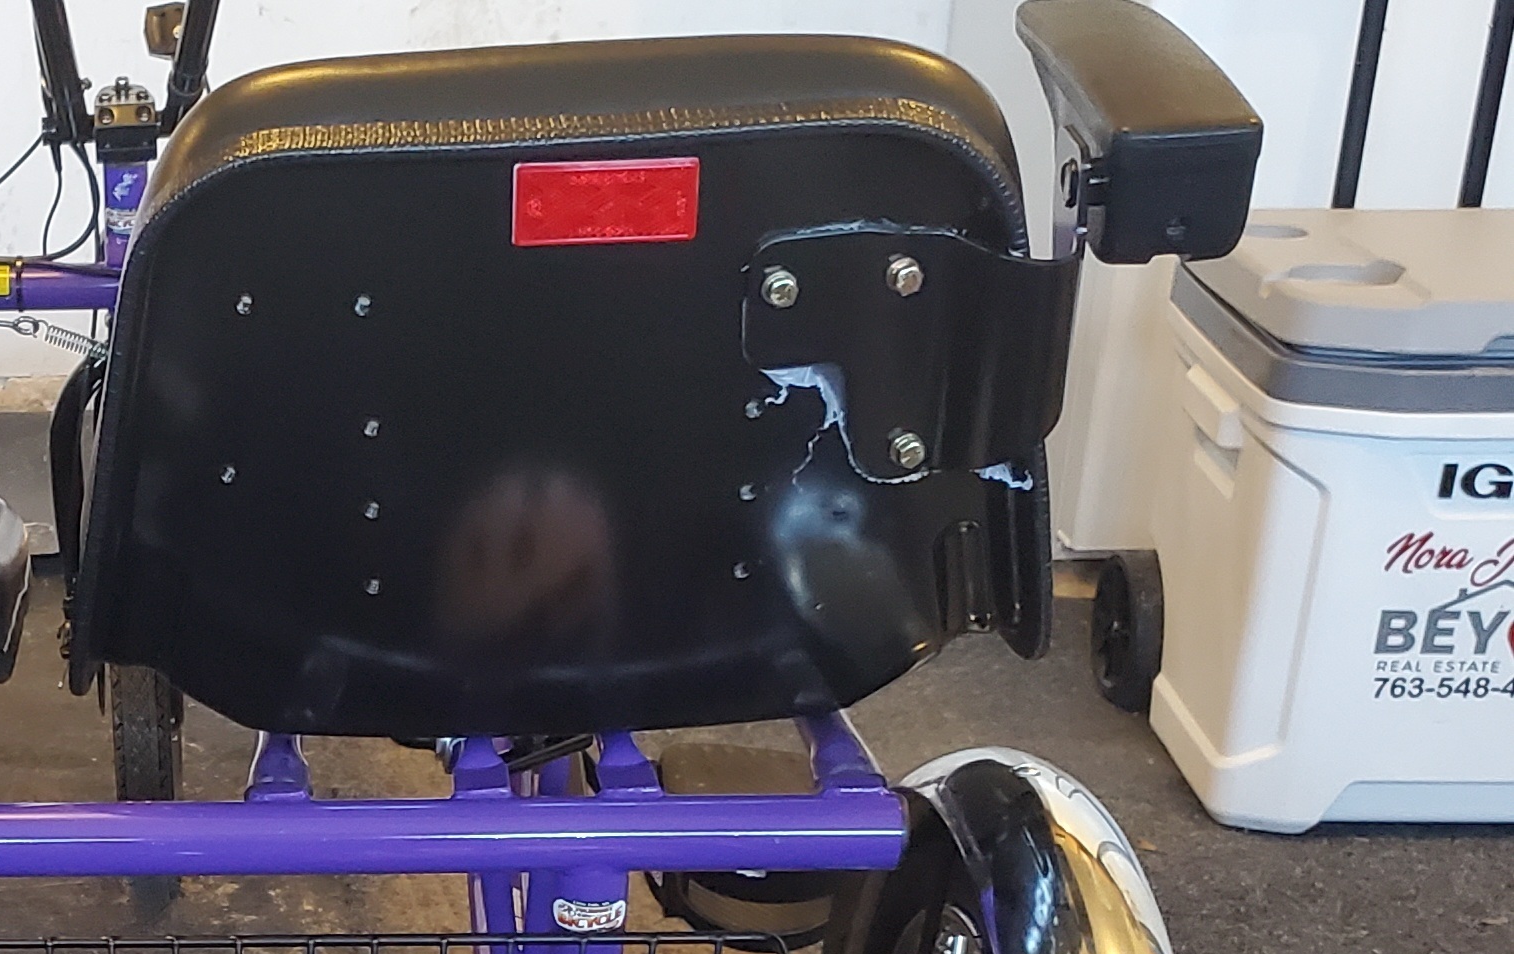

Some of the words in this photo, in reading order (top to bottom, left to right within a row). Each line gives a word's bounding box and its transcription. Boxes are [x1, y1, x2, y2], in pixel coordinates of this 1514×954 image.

[1384, 531, 1474, 574] Nora
[1373, 609, 1514, 655] BEY
[1375, 661, 1422, 673] REAL
[1433, 661, 1502, 674] ESTATE
[1373, 677, 1514, 699] 763-548-4
